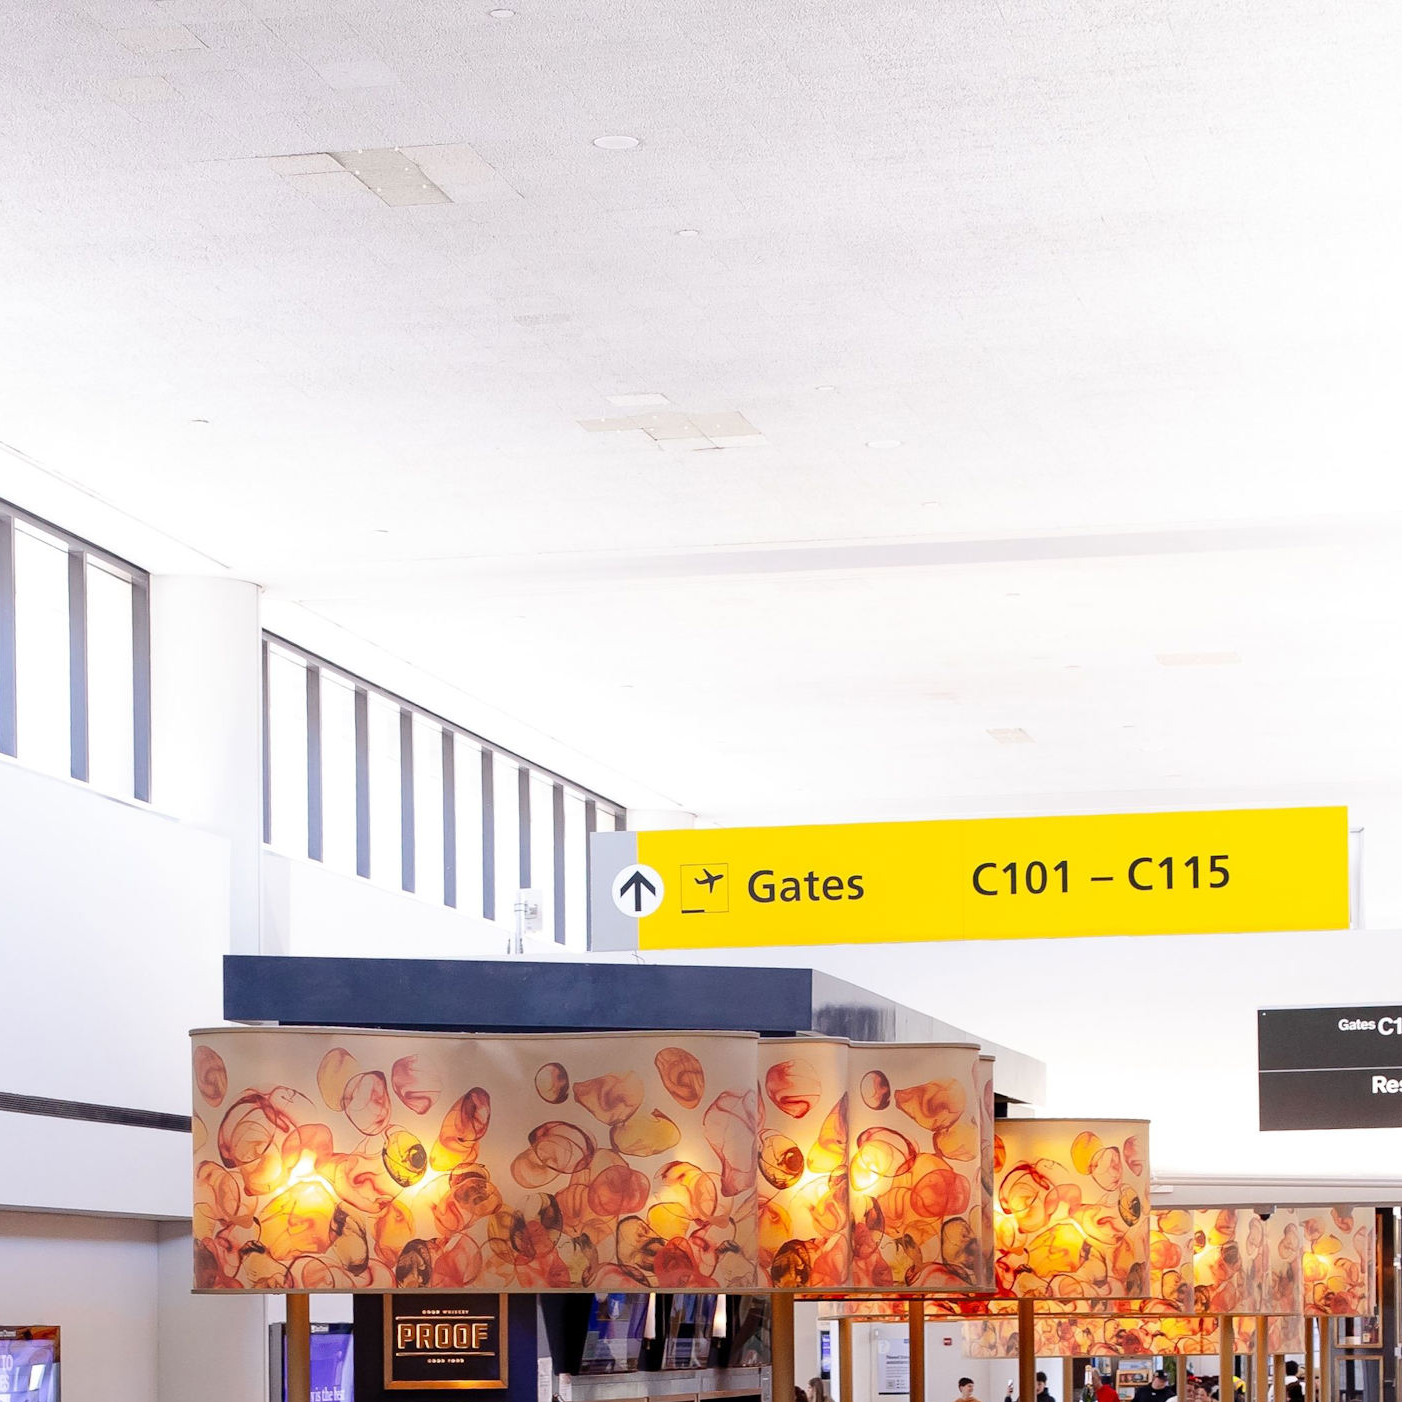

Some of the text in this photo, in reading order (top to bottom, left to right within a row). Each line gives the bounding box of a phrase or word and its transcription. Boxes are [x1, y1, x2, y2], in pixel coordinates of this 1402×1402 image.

[747, 869, 865, 903] Gates
[972, 860, 1069, 896] C101
[1128, 854, 1231, 891] C115
[1338, 1018, 1376, 1031] Gates
[397, 1323, 488, 1349] PROOF
[0, 1354, 13, 1371] TO
[315, 1387, 321, 1402] is
[322, 1386, 333, 1402] the
